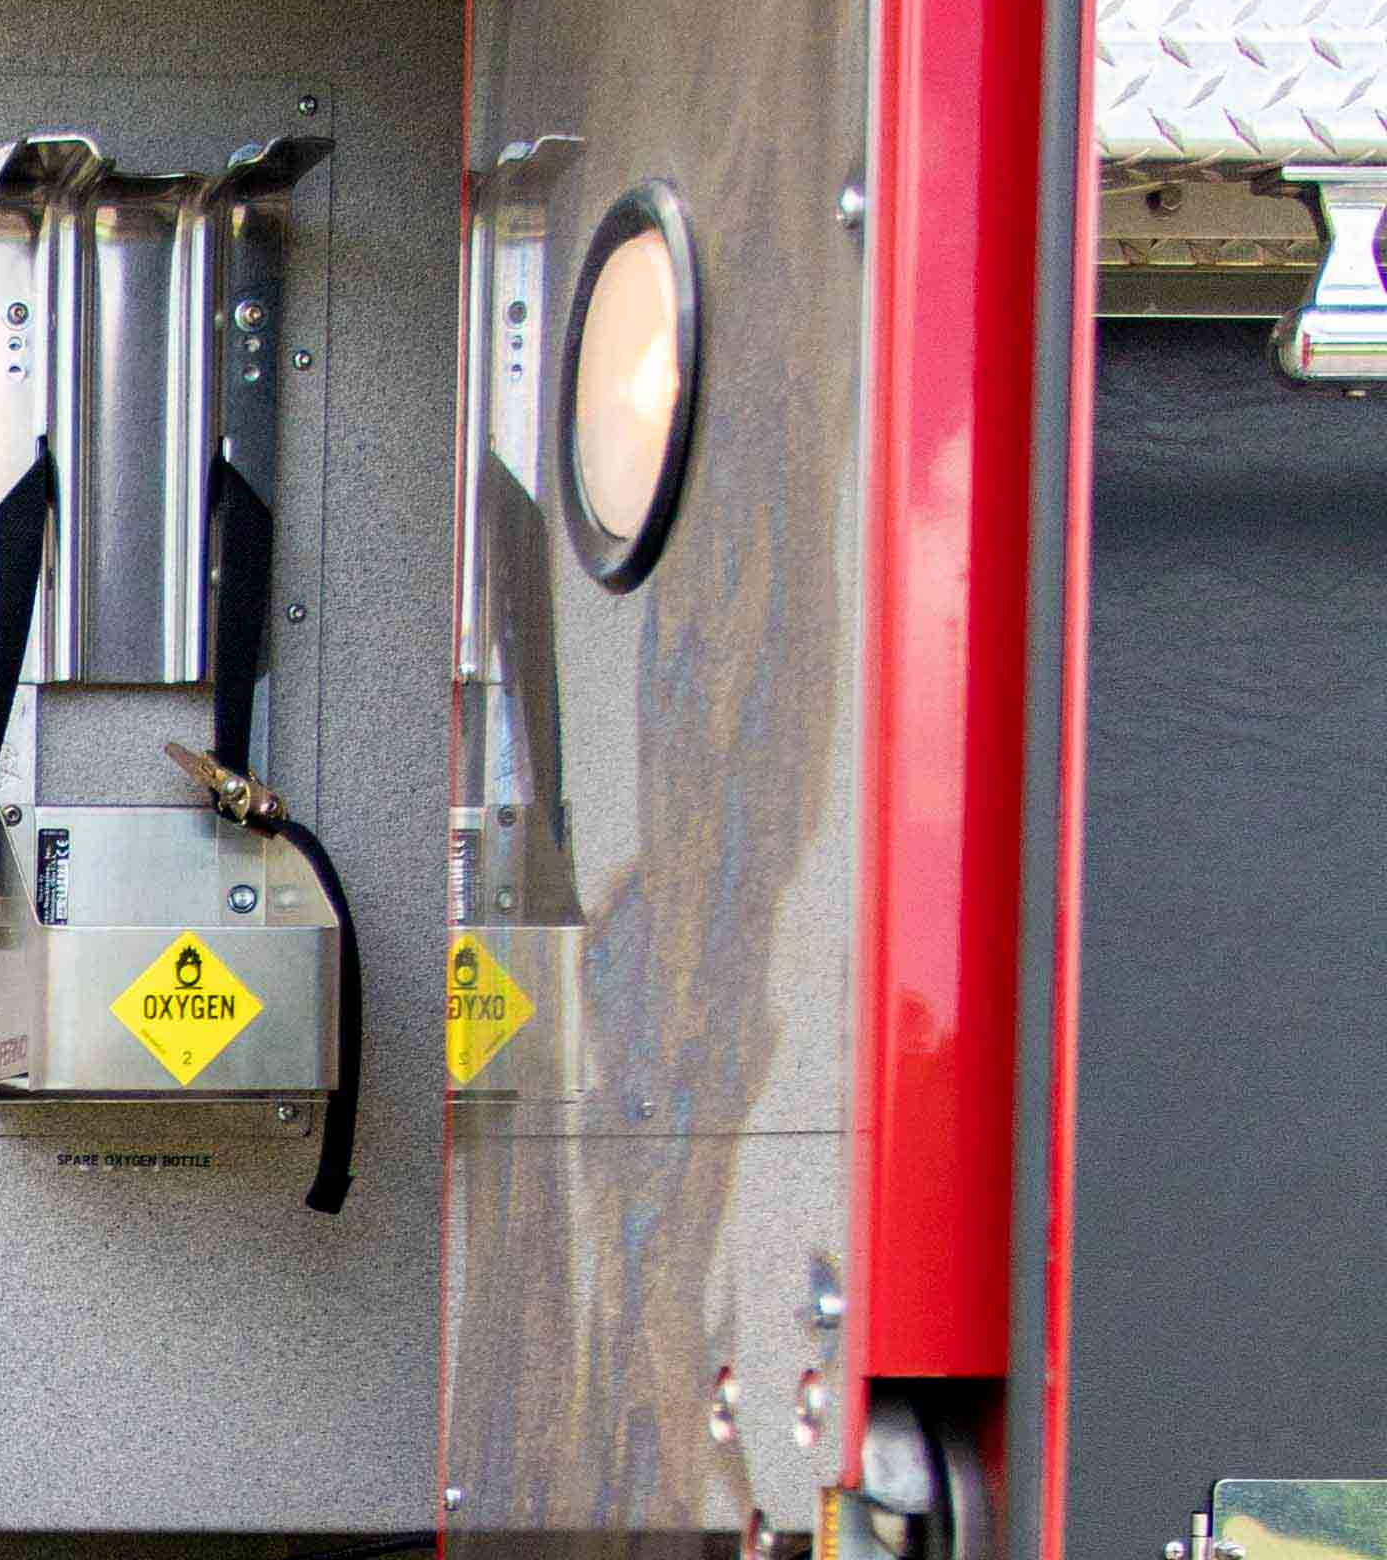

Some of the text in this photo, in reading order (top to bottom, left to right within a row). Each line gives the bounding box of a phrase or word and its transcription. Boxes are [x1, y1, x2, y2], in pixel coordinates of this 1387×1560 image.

[143, 994, 235, 1020] OXYGEN
[182, 1050, 193, 1065] 2
[56, 1153, 212, 1168] SPARE OXYGEN BOTTLE
